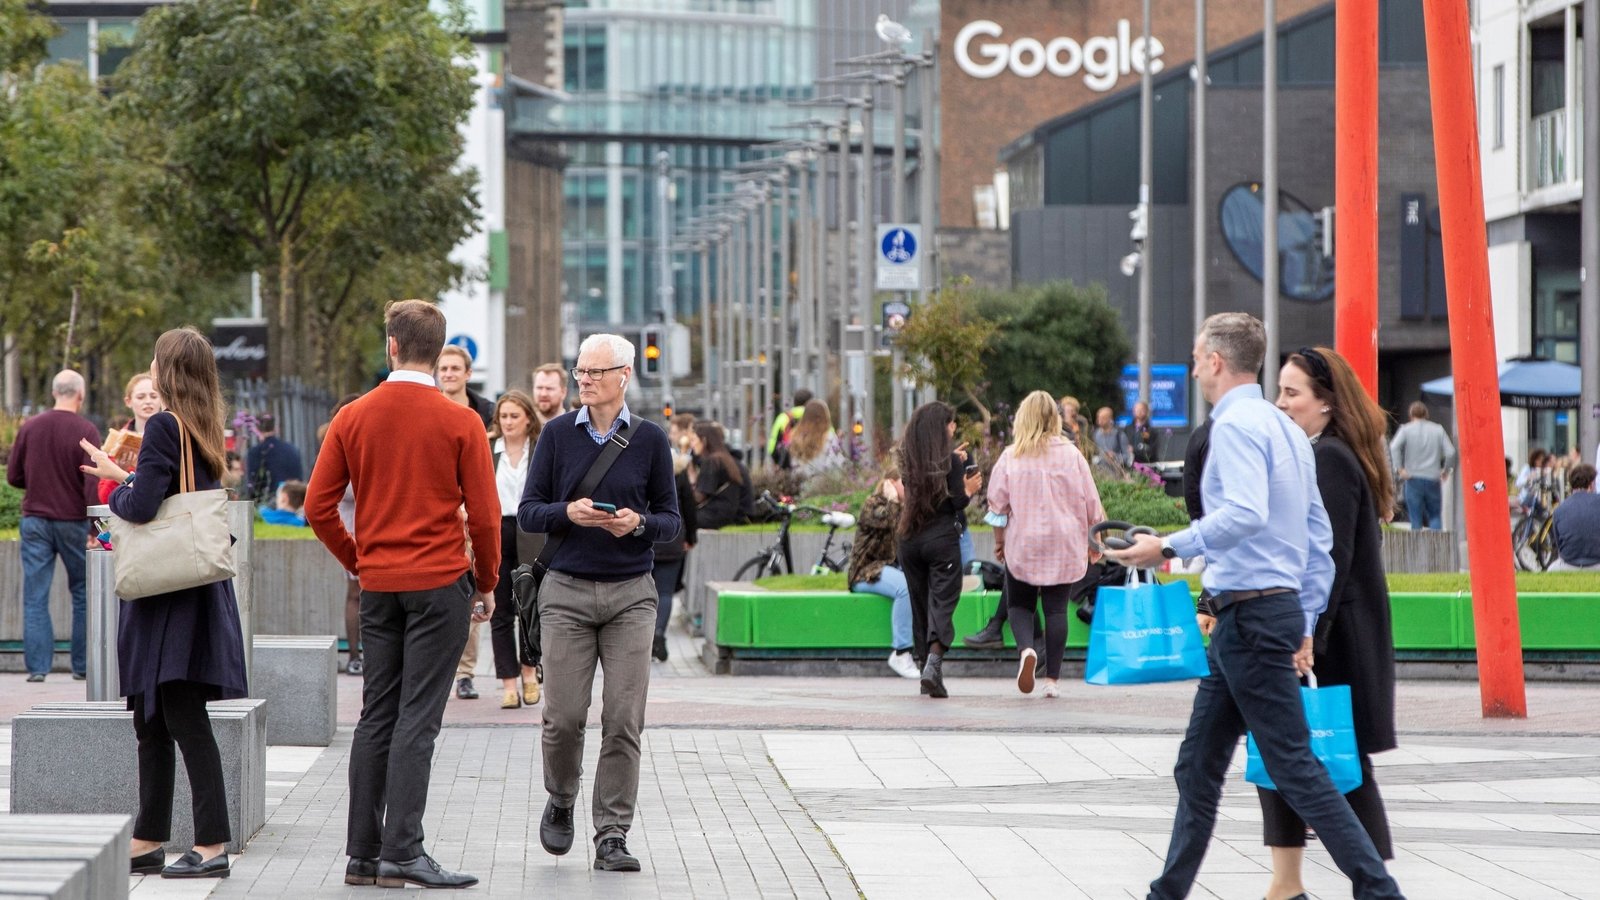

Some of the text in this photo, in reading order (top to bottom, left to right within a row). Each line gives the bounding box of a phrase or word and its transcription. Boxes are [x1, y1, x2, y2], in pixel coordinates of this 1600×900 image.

[953, 18, 1165, 92] Google
[1406, 200, 1419, 226] THE
[1123, 629, 1149, 639] LOLLY
